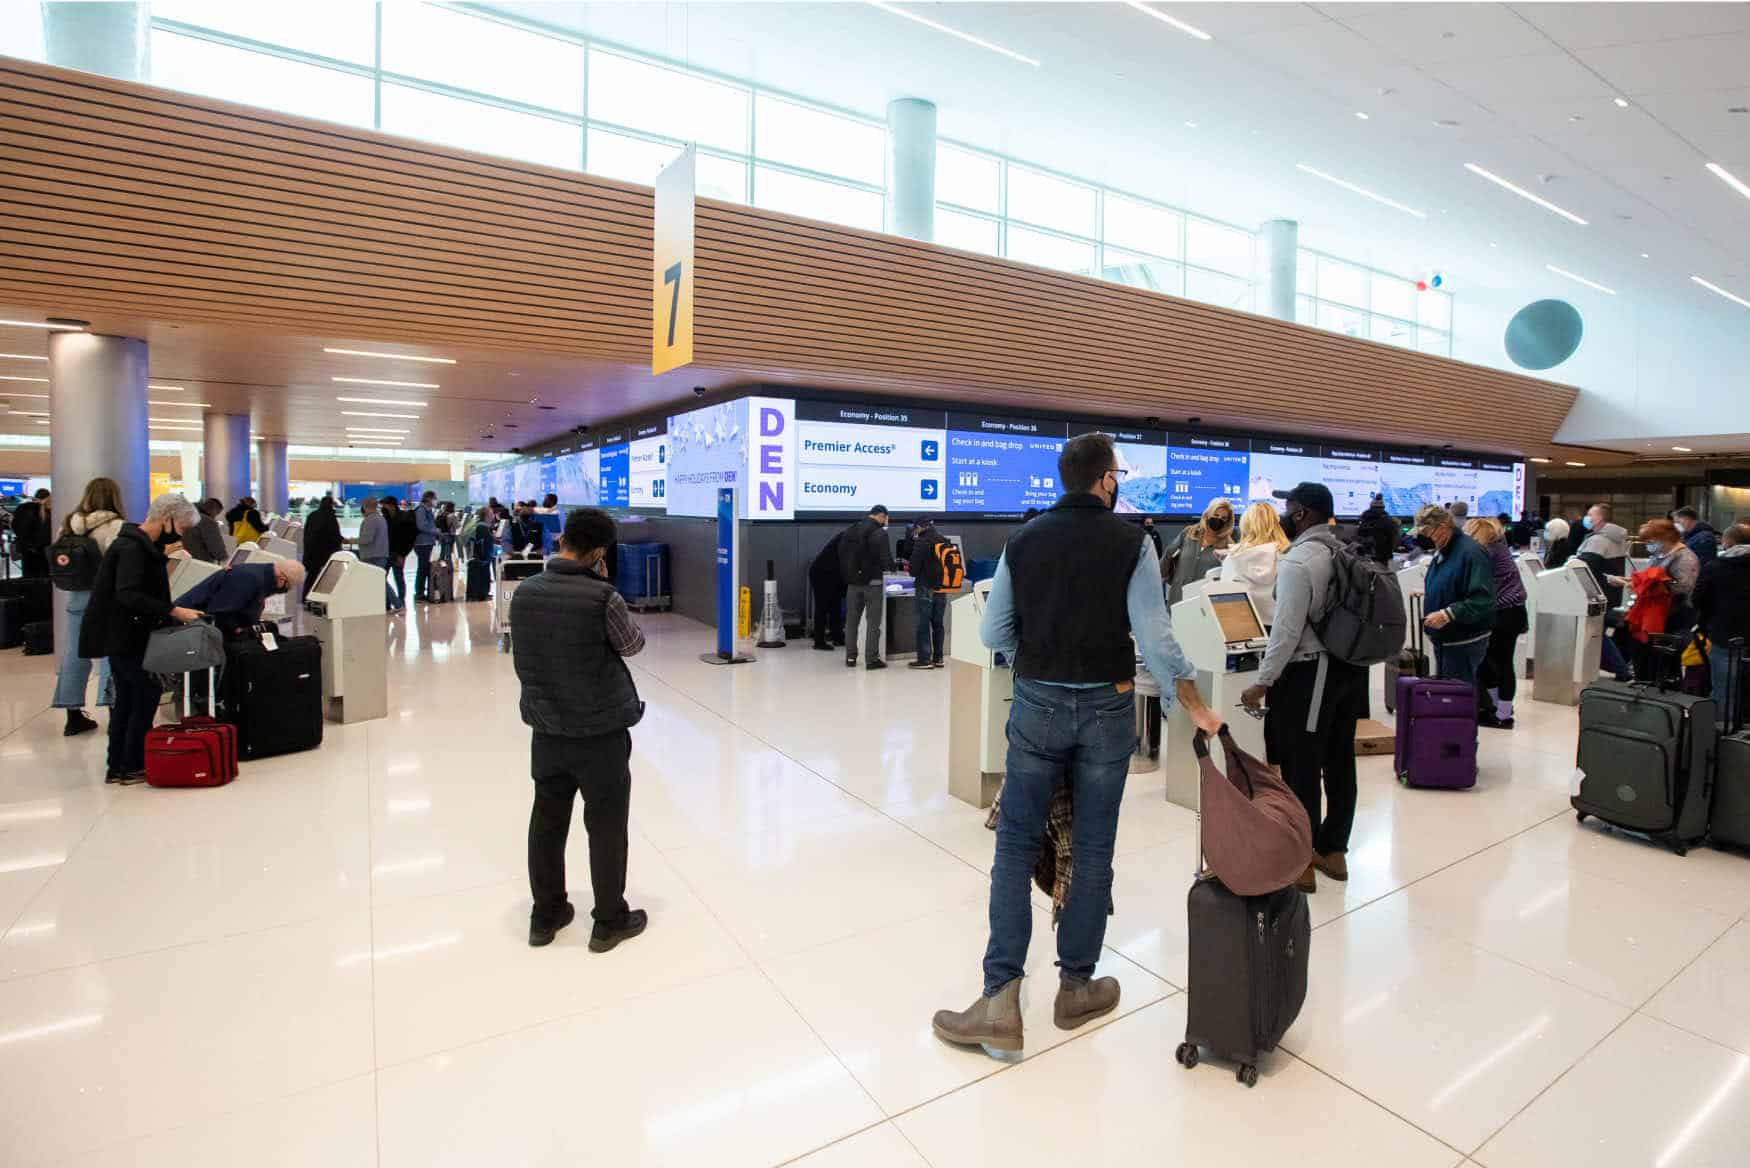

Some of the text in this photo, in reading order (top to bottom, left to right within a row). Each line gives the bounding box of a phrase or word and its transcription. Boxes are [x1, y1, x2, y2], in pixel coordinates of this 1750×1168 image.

[663, 260, 682, 348] 7
[840, 410, 869, 421] Economy
[874, 412, 900, 422] Position
[804, 439, 852, 452] Premier
[952, 438, 1023, 450] Check in and bag drop
[760, 407, 785, 511] DEN
[952, 456, 967, 465] Start
[804, 481, 857, 496] Economy
